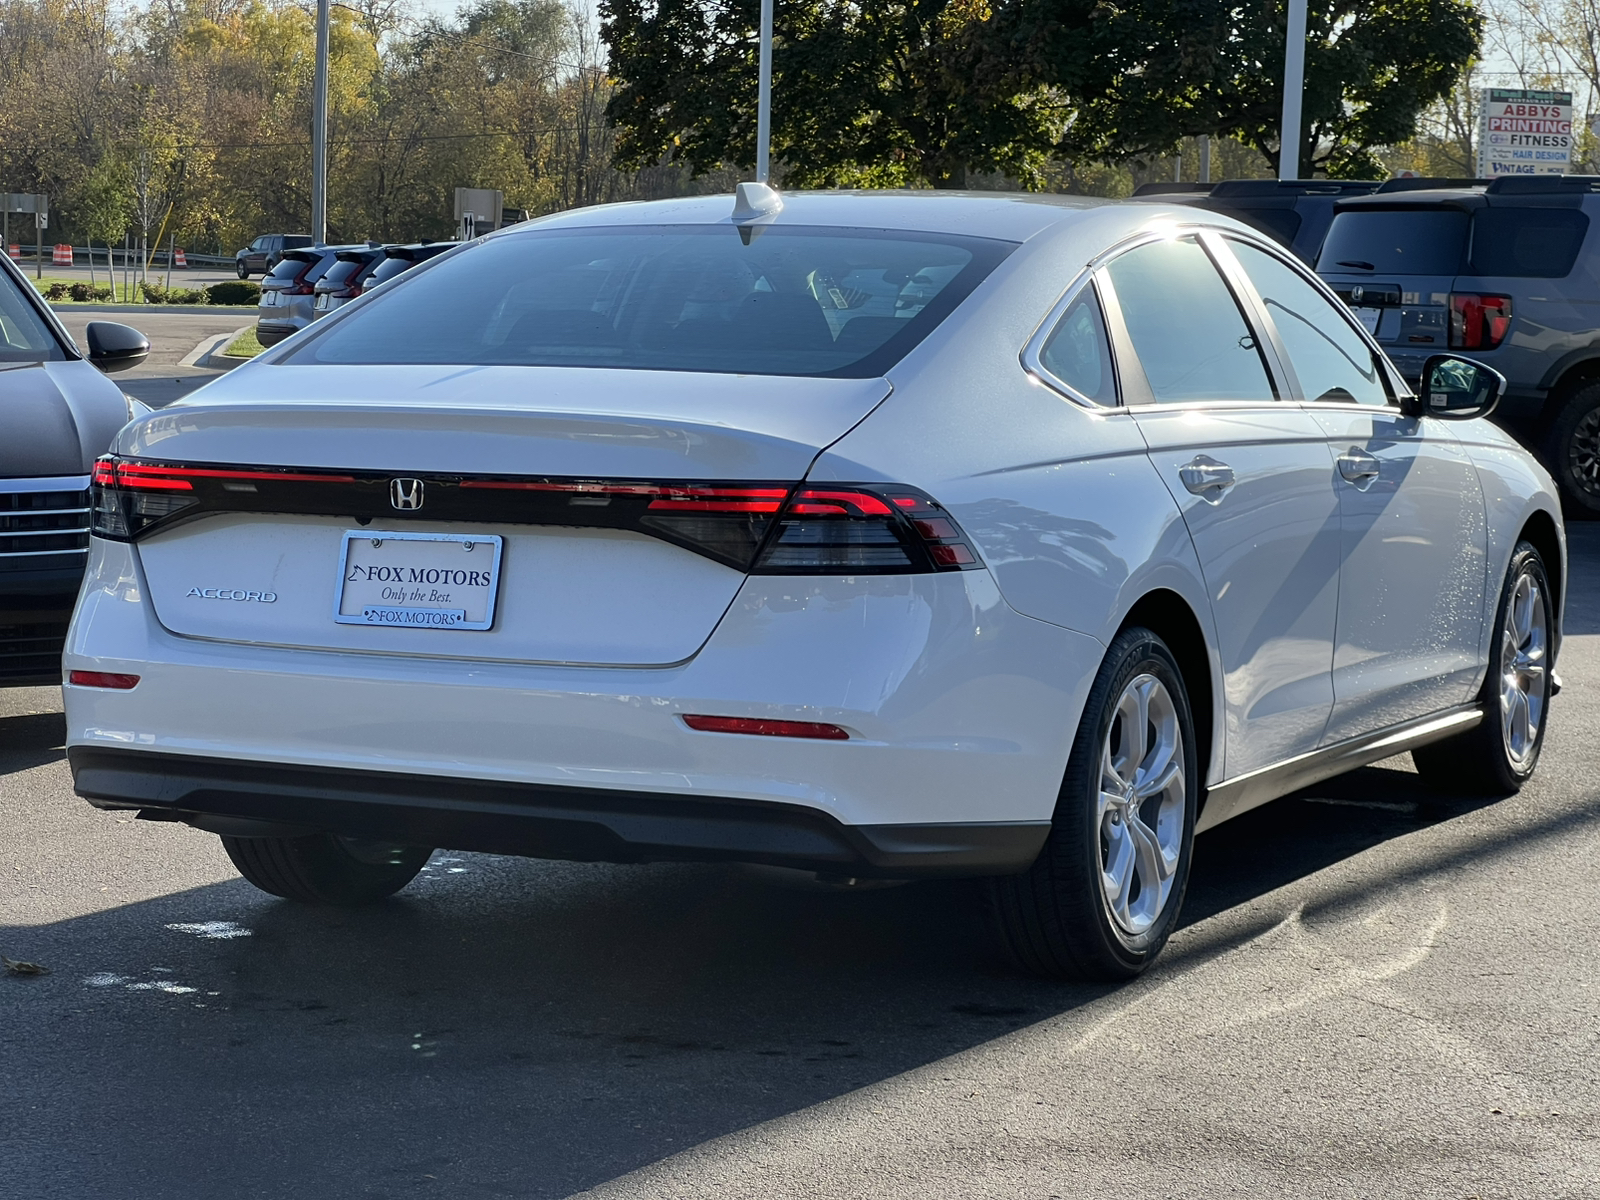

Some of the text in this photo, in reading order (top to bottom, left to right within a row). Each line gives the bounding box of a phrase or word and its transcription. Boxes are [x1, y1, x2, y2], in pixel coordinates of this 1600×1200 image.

[1503, 105, 1561, 118] ABBYS
[1490, 118, 1570, 133] PRINTING
[1510, 134, 1568, 147] FITNESS
[1512, 150, 1533, 159] HAIR
[1535, 151, 1567, 160] DESIGN
[1491, 162, 1535, 174] VINTAGE
[366, 566, 491, 587] FOX MOTORS
[185, 587, 278, 603] ACCORD
[381, 586, 452, 604] Only the Best.
[379, 610, 456, 626] FOX MOTORS
